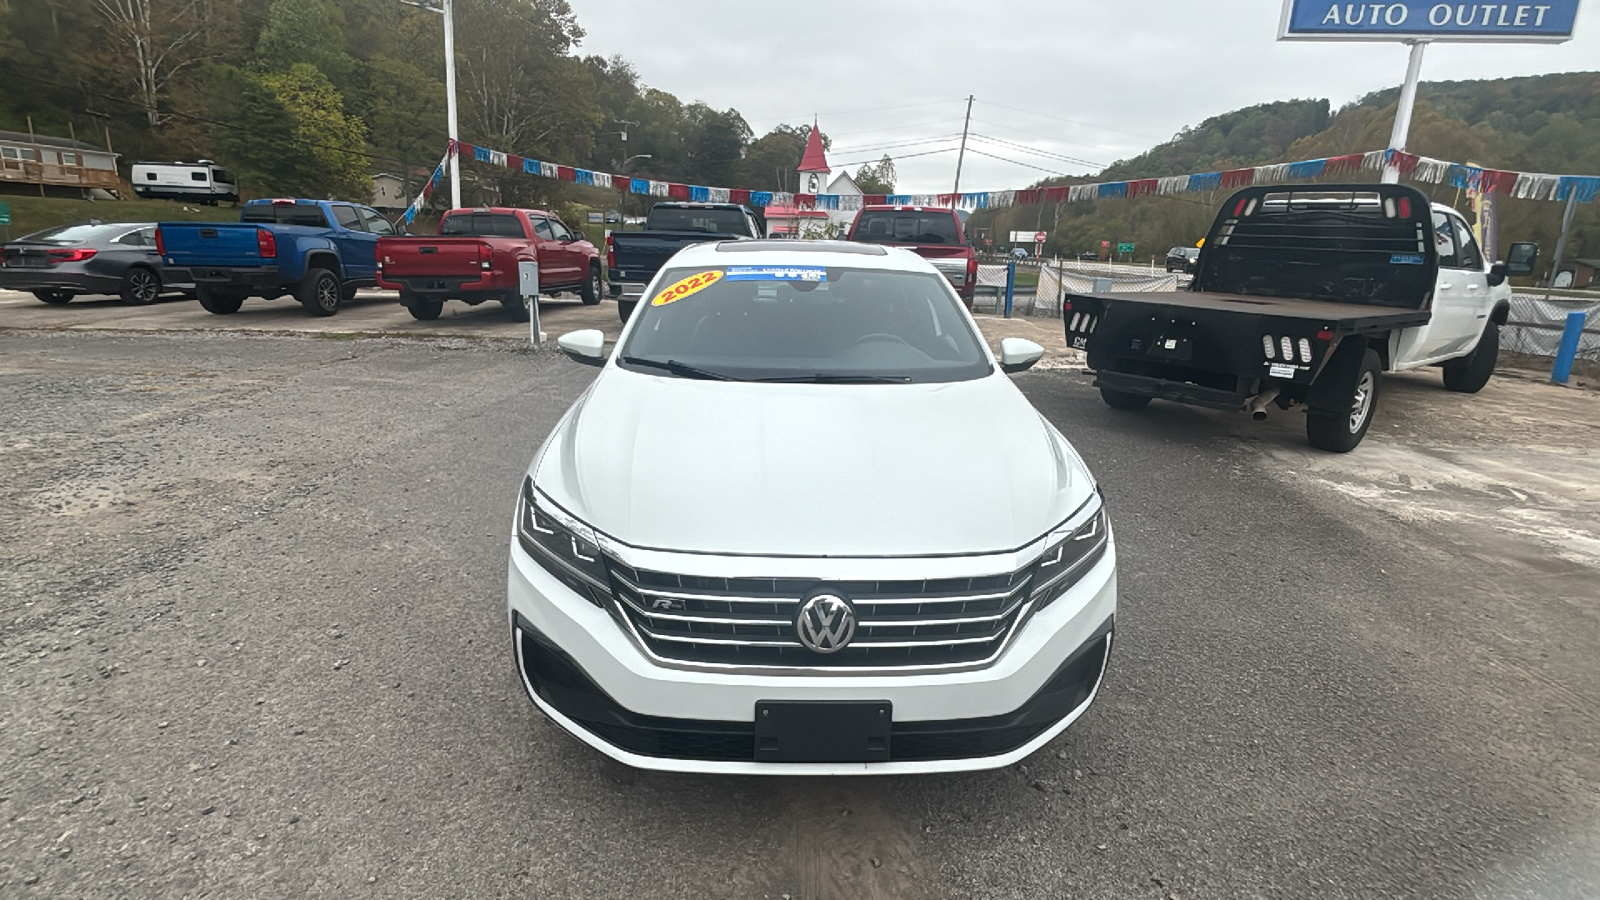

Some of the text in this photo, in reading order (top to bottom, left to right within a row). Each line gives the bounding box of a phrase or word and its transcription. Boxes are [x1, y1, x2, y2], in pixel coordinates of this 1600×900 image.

[1321, 3, 1550, 27] AUTO OUTLET
[661, 272, 717, 303] 2022
